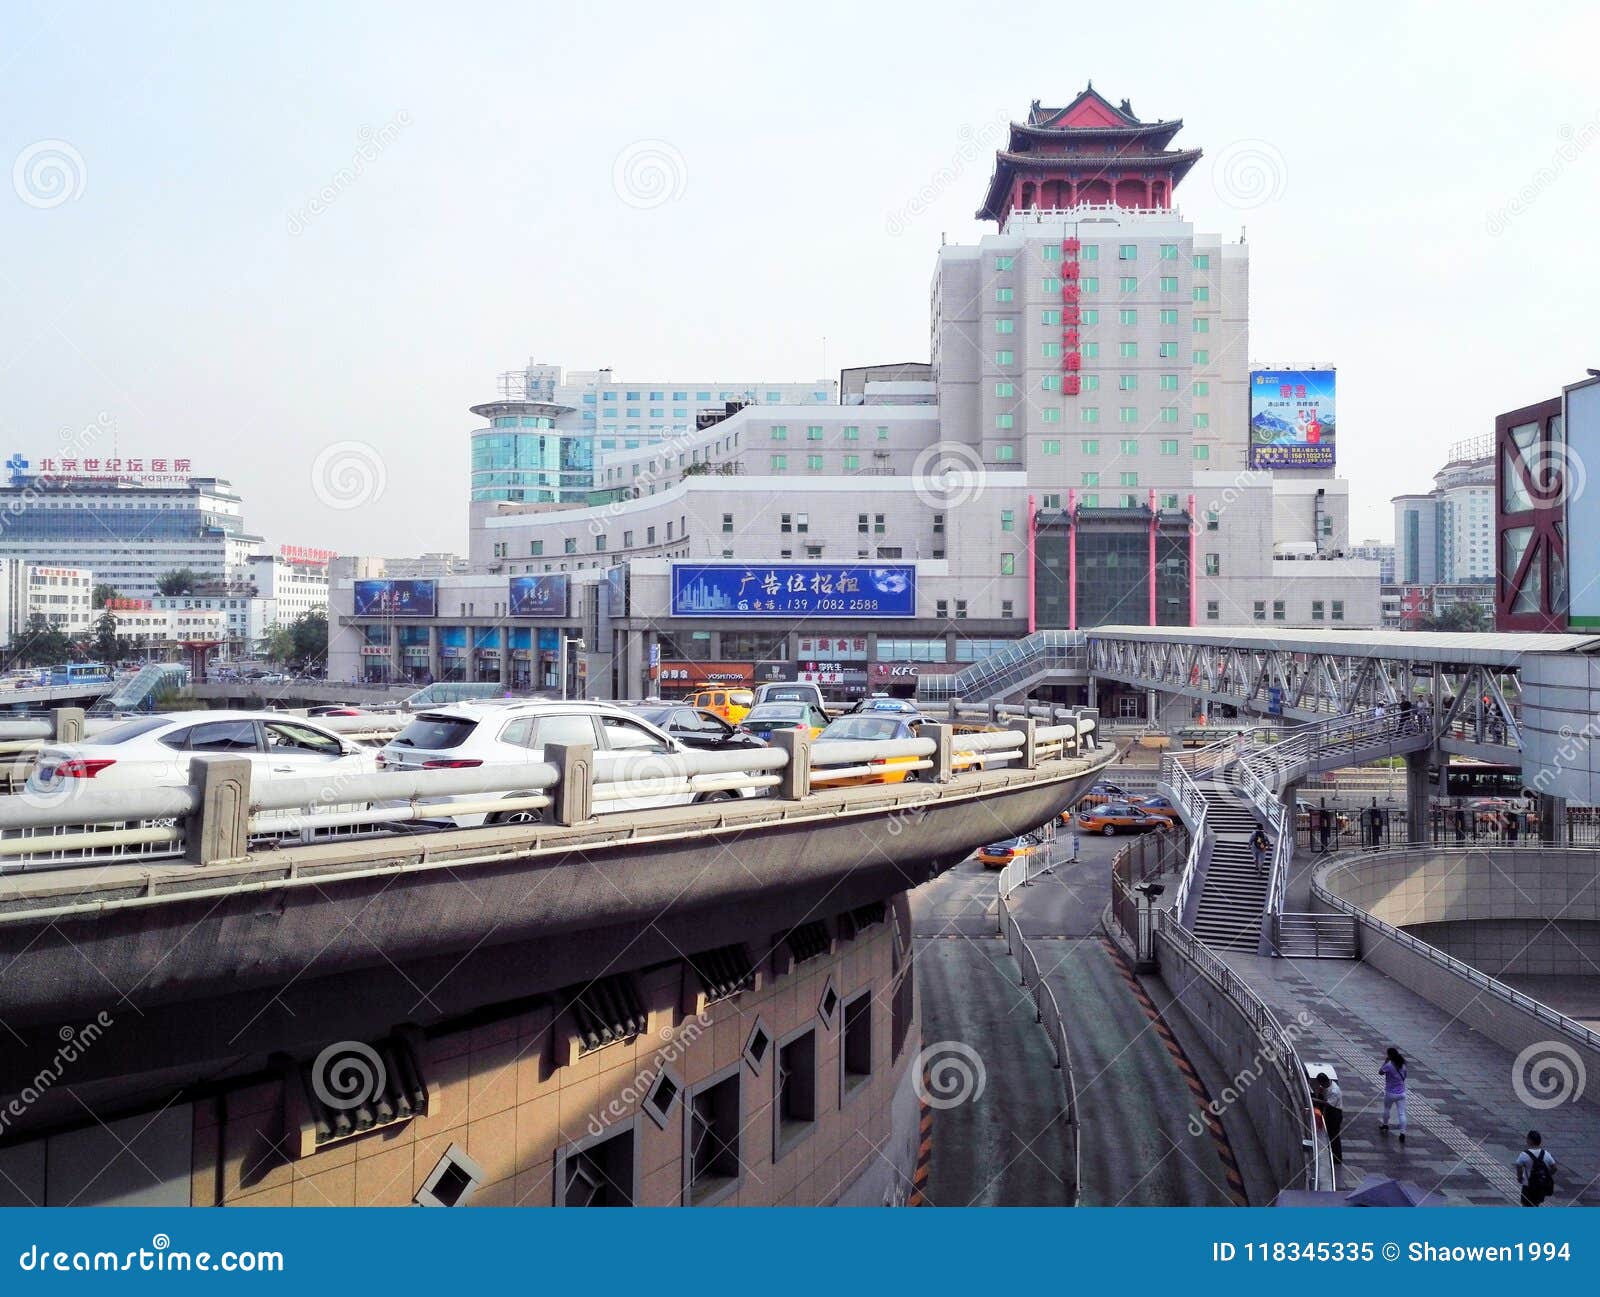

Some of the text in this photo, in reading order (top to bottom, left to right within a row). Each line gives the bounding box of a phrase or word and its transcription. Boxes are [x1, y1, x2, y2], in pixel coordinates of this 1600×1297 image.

[40, 458, 192, 472] 北京世纪坛医院
[738, 571, 860, 596] 广告位招租
[787, 599, 808, 610] 139
[816, 599, 845, 610] 1082
[850, 599, 878, 610] 2588
[661, 669, 688, 679] 吉野家
[891, 667, 918, 676] KFC
